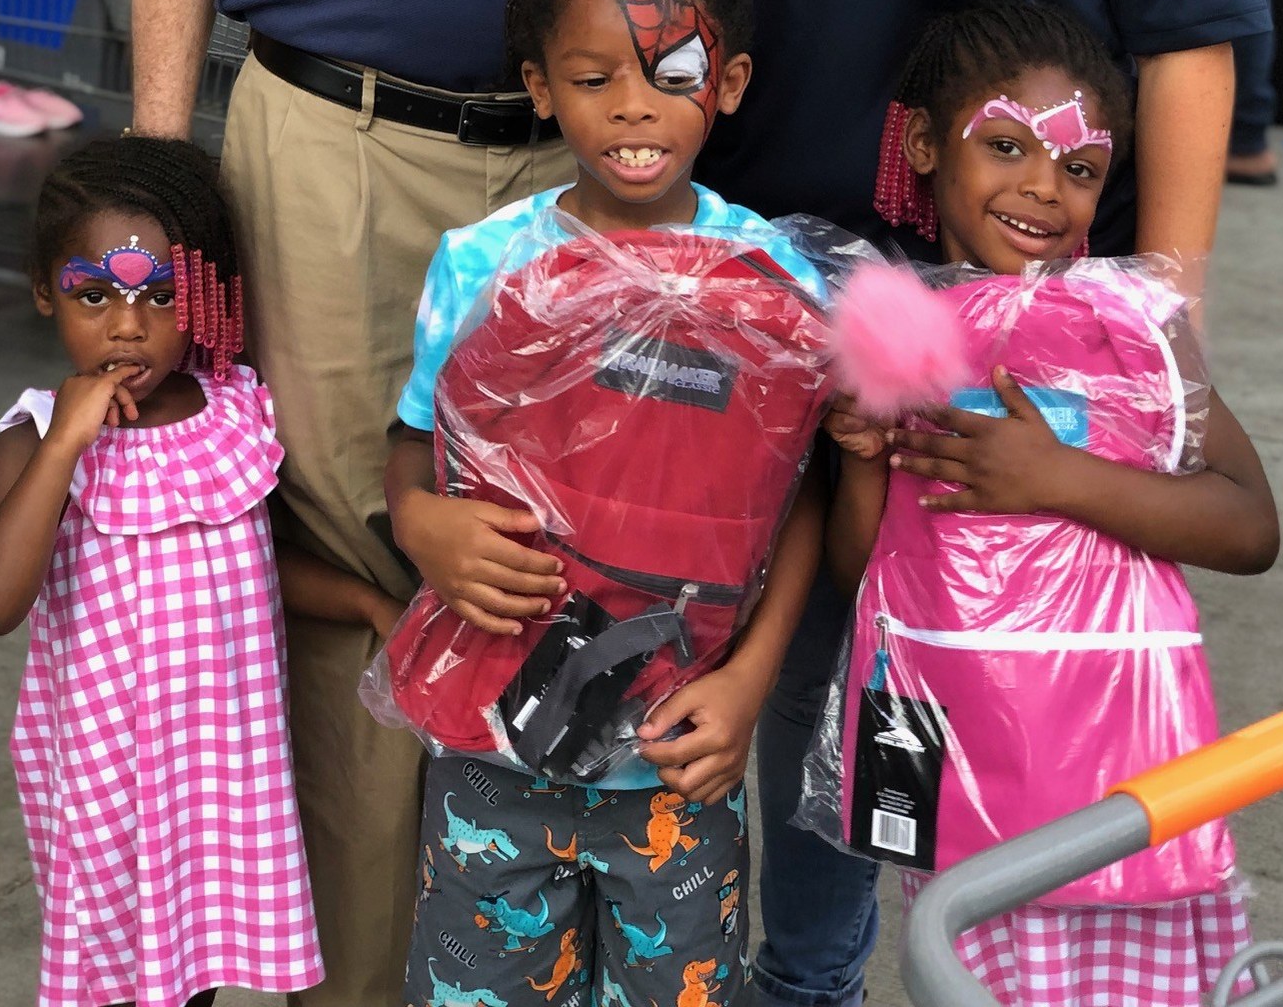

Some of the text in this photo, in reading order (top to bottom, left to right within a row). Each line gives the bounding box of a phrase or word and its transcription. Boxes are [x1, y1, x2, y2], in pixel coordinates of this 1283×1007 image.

[675, 378, 721, 394] CLASSIC
[463, 762, 500, 806] CHILL
[672, 866, 714, 901] CHILL
[439, 930, 477, 969] CHILL
